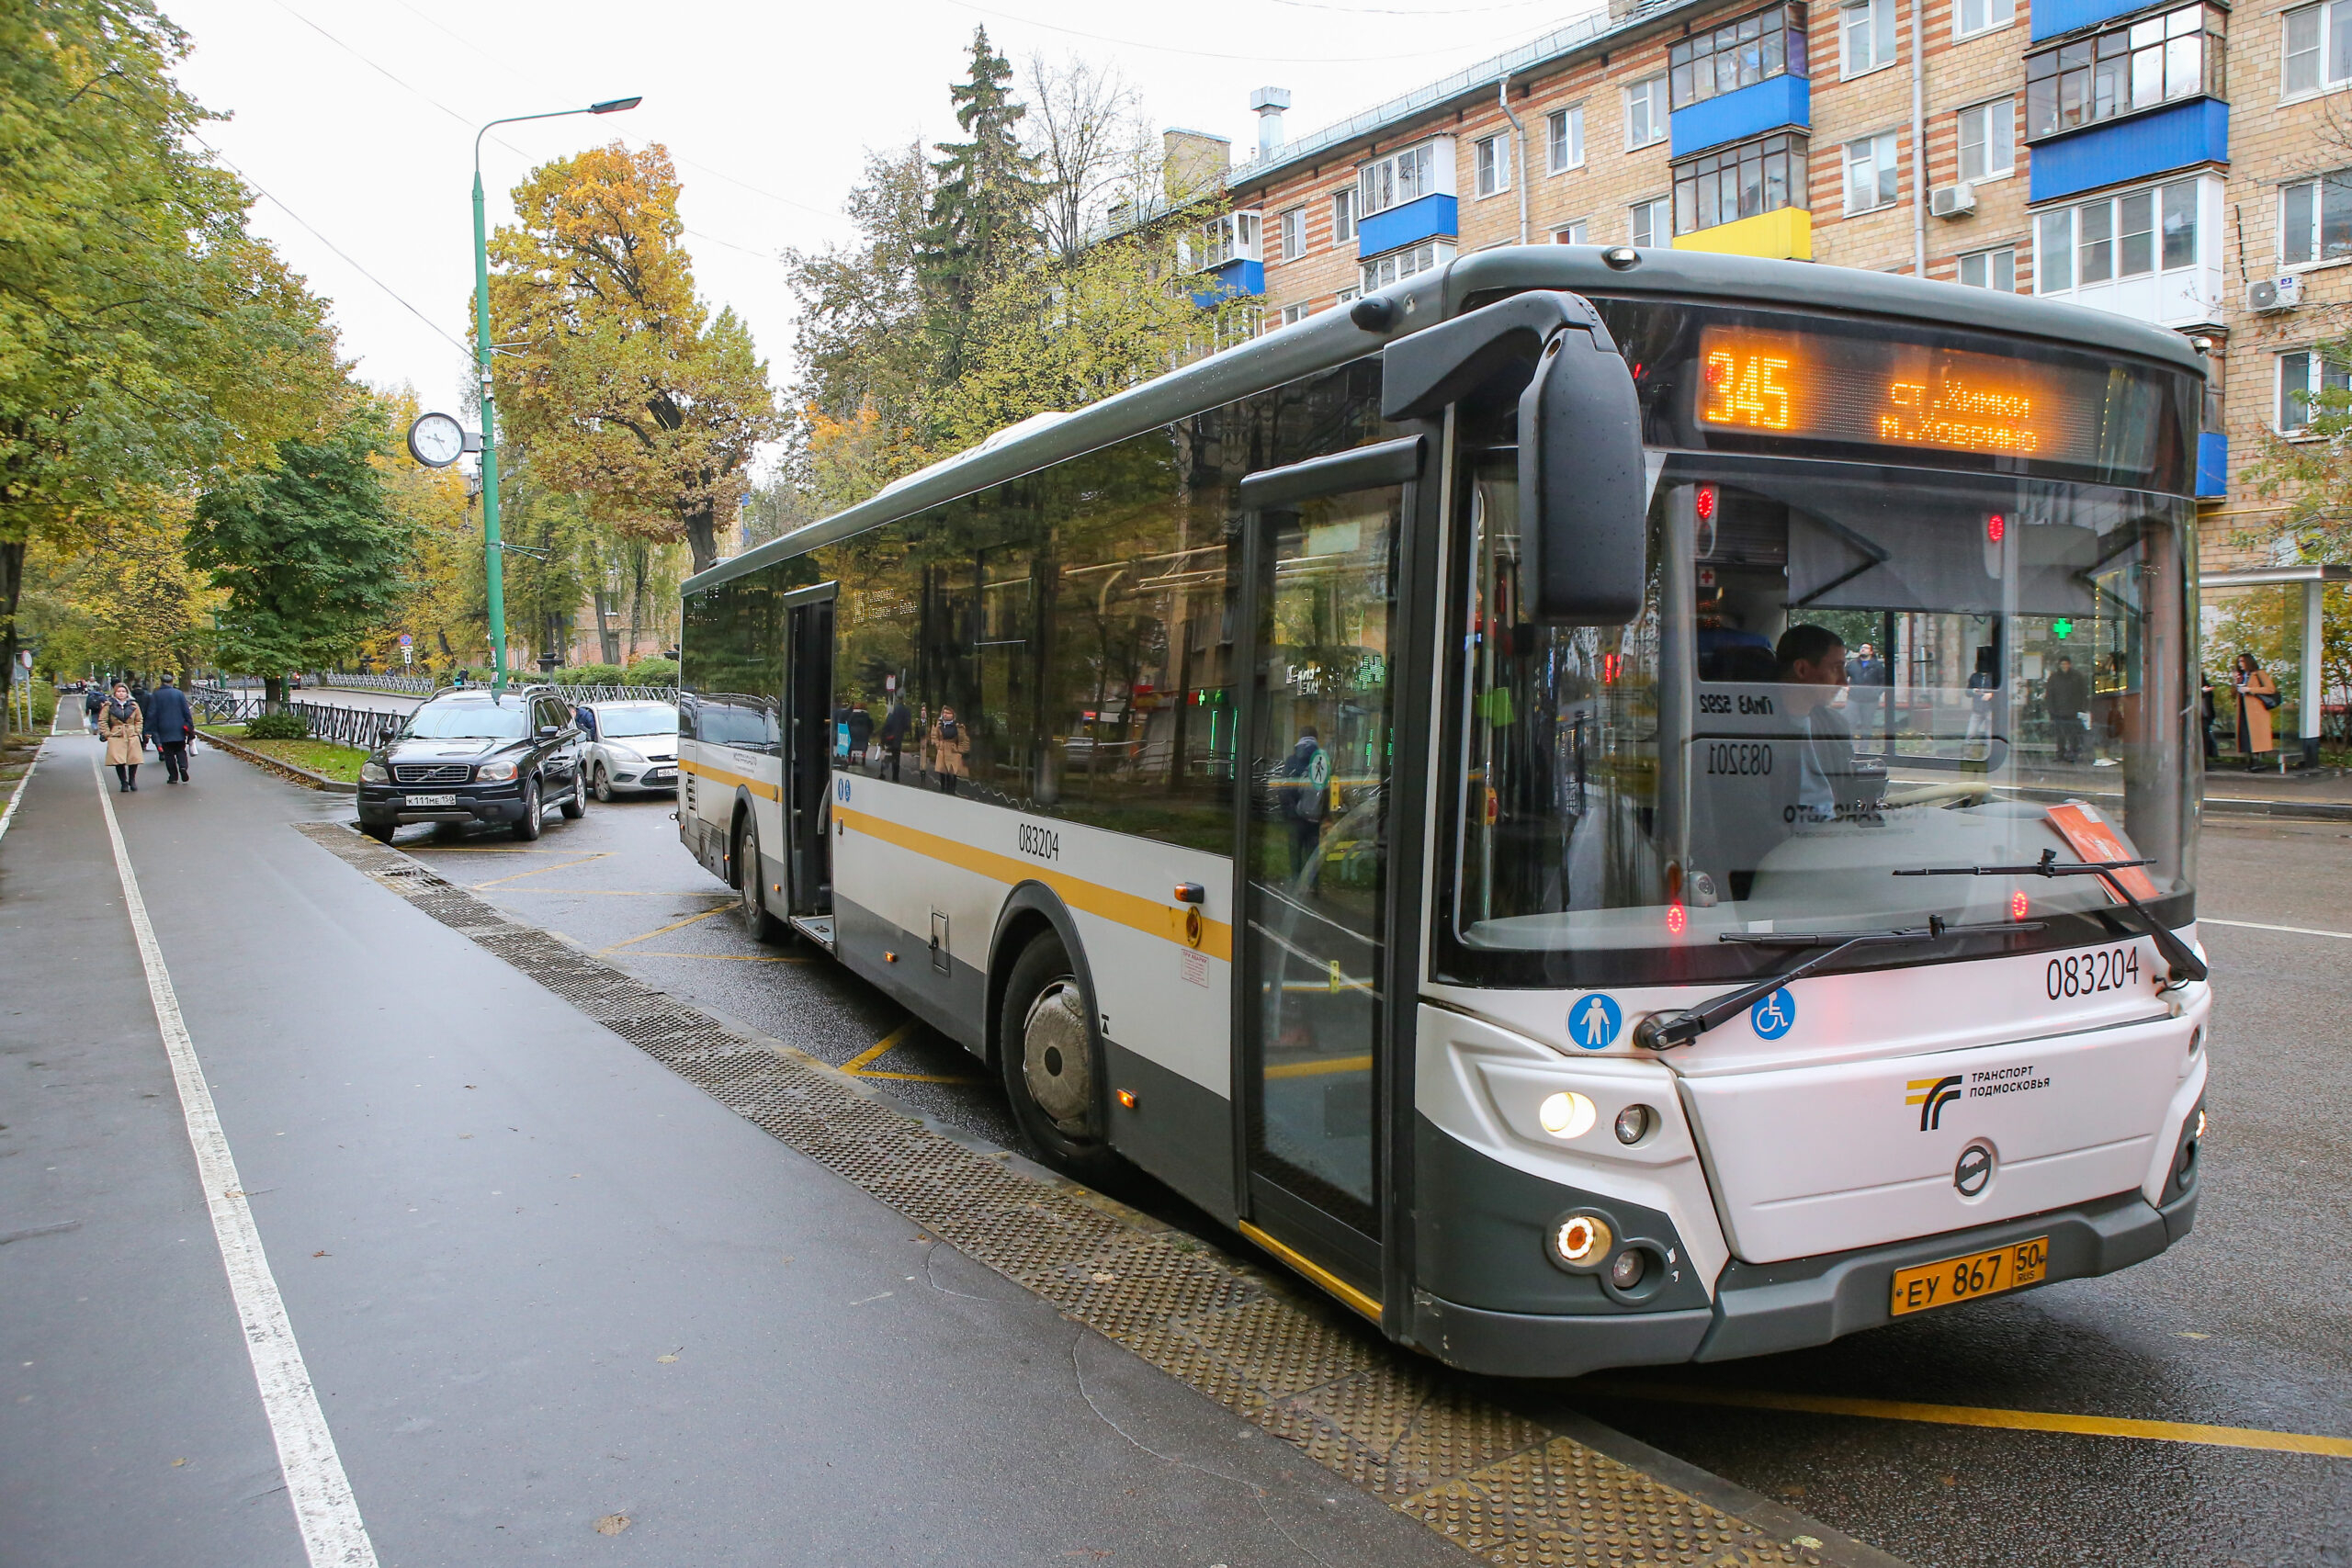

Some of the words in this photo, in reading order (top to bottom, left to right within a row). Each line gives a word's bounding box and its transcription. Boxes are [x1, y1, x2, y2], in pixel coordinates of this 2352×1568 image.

[1708, 351, 1788, 429] 345
[1019, 823, 1059, 862] 083204
[2047, 946, 2140, 1000] 083204
[1970, 1077, 2051, 1098] ПОДМОСКОВЬЯ
[1972, 1066, 2034, 1083] ТРАНСПОРТ
[1952, 1254, 2002, 1296] 867
[2016, 1243, 2040, 1271] 50
[2018, 1269, 2035, 1281] RUS
